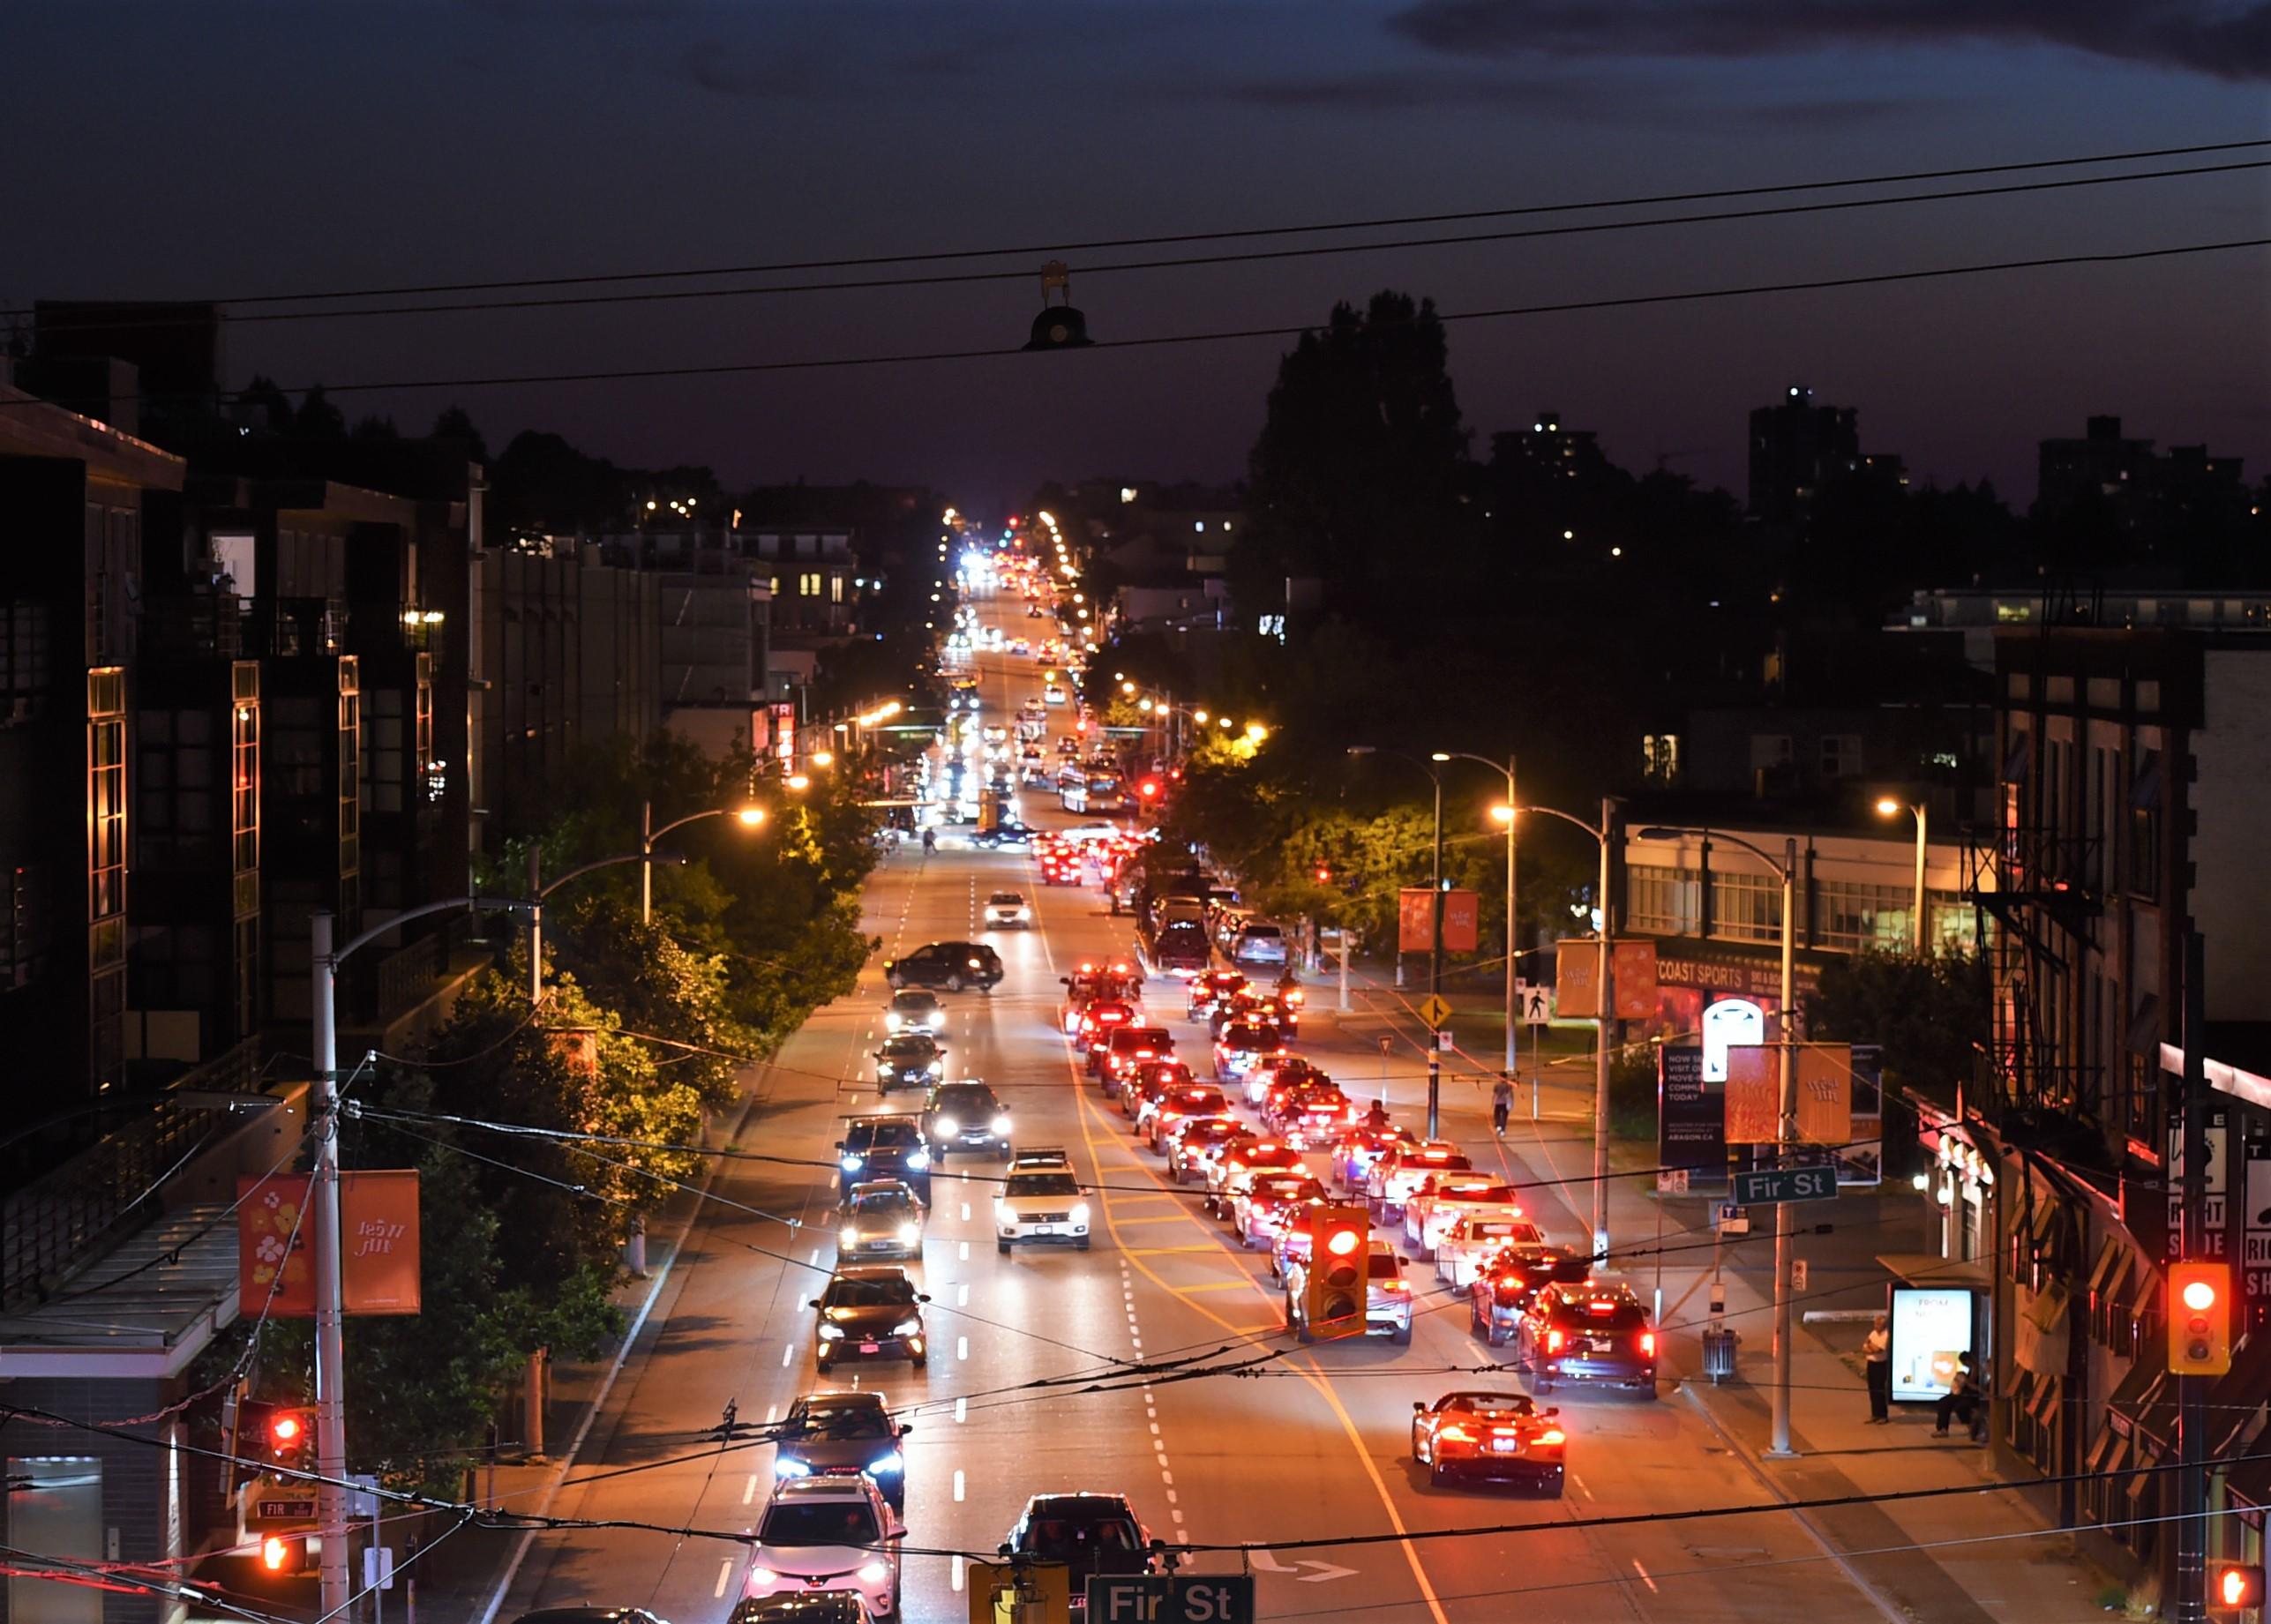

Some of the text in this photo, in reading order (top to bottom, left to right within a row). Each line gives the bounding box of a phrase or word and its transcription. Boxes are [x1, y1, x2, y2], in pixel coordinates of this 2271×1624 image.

[1655, 961, 1743, 988] COAST SPORTS
[1668, 1093, 1699, 1102] TODAY
[1748, 1173, 1824, 1198] Fir St
[2170, 1201, 2223, 1223] RHT
[2169, 1230, 2223, 1255] SE
[267, 1503, 285, 1515] FIR
[1109, 1584, 1232, 1621] Fir St
